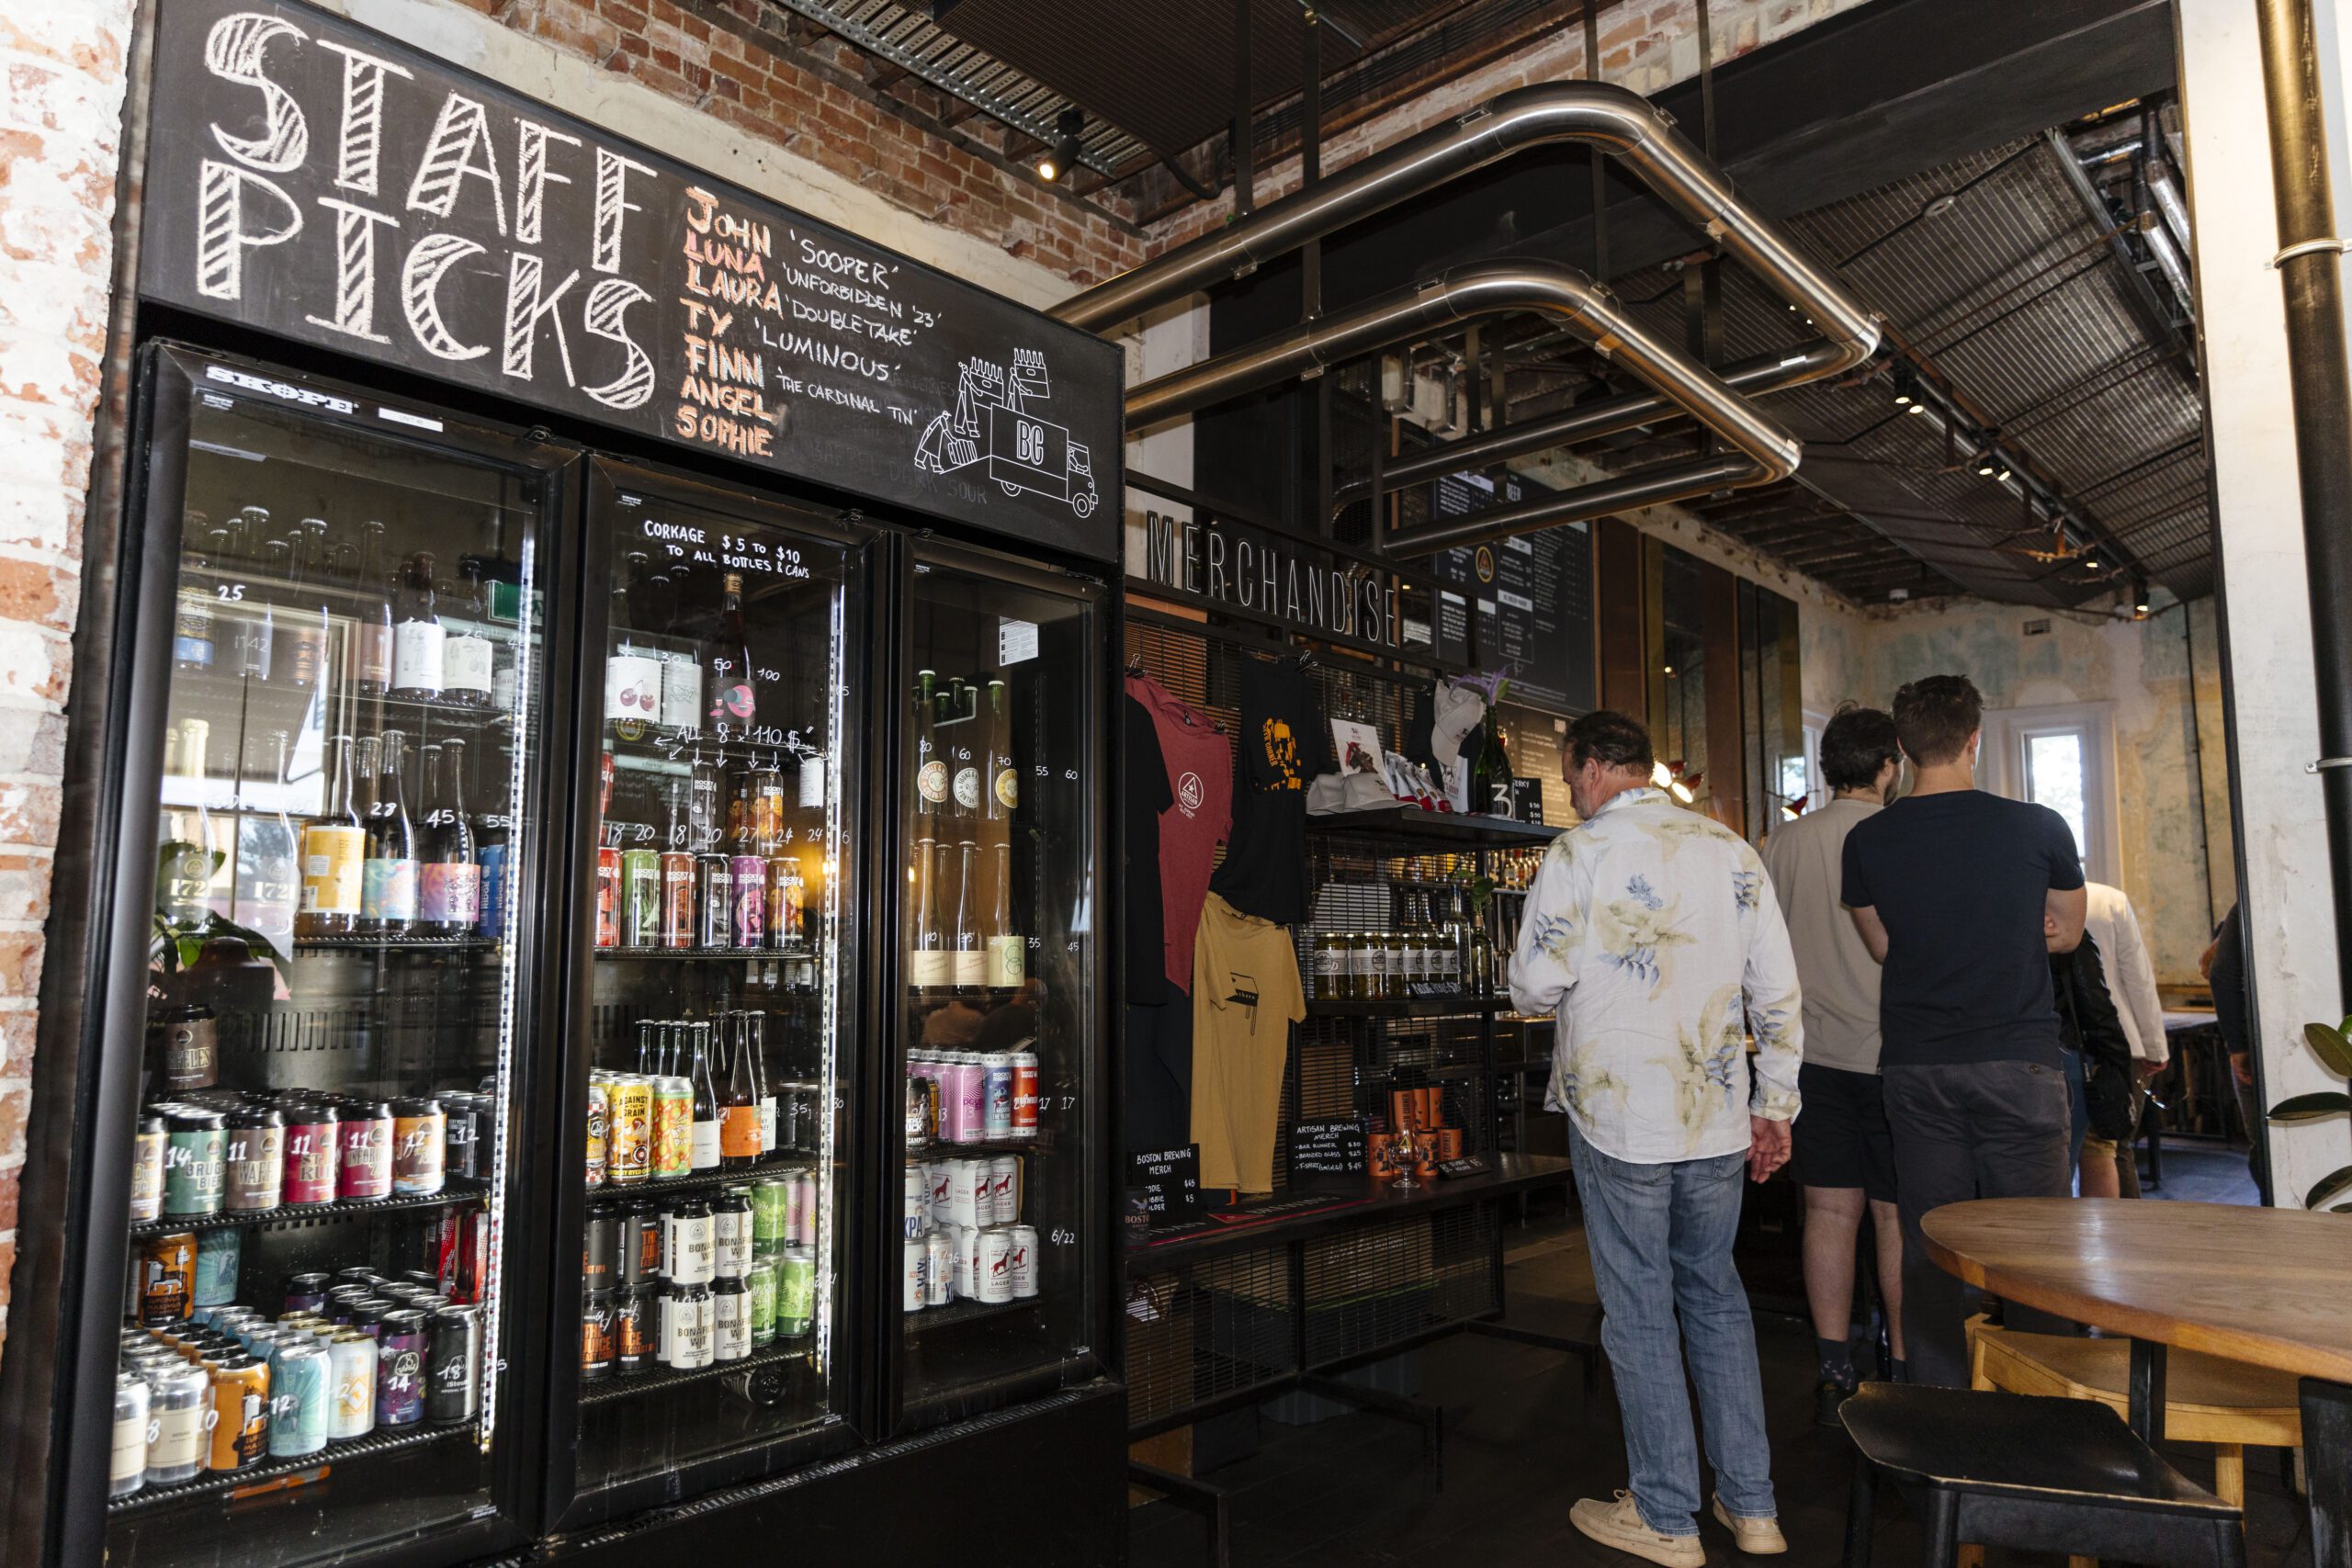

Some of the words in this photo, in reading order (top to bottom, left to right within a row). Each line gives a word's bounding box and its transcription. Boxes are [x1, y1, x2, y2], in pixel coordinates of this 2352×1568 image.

[206, 13, 658, 274] STAFF
[685, 186, 771, 258] JOHN
[684, 231, 765, 280] LUNA
[198, 159, 655, 410] PICKS
[684, 259, 784, 320] LAURA
[679, 298, 733, 337] TY
[683, 333, 765, 389] FINN
[808, 383, 880, 413] CARDINAL
[206, 366, 354, 414] SKOPE
[681, 375, 777, 425] ANGEL
[675, 407, 773, 457] SOPHIE
[644, 519, 706, 544] CORKAGE
[752, 543, 766, 554] TO
[776, 546, 800, 564] $10
[666, 544, 684, 557] TO
[694, 550, 716, 563] ALL
[723, 554, 772, 571] BOTTLES
[785, 564, 810, 579] CANS
[1148, 512, 1399, 647] MERCHANDISE
[218, 584, 246, 602] 25
[714, 658, 732, 670] 50
[757, 668, 780, 681] 100
[676, 723, 703, 740] ALL
[753, 724, 782, 744] 110
[958, 748, 971, 760] 60
[998, 756, 1012, 765] 70
[1035, 766, 1048, 776] 55
[1066, 770, 1078, 780] 60
[370, 801, 397, 817] 28
[426, 809, 456, 828] 45
[606, 824, 625, 845] 18
[635, 823, 655, 841] 20
[669, 824, 687, 845] 18
[739, 826, 759, 843] 27
[776, 827, 793, 844] 24
[808, 827, 822, 842] 24
[1028, 937, 1040, 948] 35
[1068, 942, 1079, 952] 45
[619, 1095, 649, 1106] AGAINST
[1039, 1097, 1051, 1110] 17
[1060, 1096, 1076, 1110] 17
[458, 1127, 480, 1144] 12
[1296, 1124, 1325, 1134] ARTISAN
[1329, 1123, 1360, 1133] BREWING
[1314, 1133, 1339, 1141] MERCH
[291, 1134, 311, 1155] 11
[350, 1132, 368, 1148] 11
[164, 1145, 192, 1168] 14
[229, 1141, 247, 1161] 11
[1136, 1152, 1161, 1165] BOSTON
[1164, 1148, 1191, 1161] BREWING
[1148, 1164, 1171, 1175] MERCH
[1185, 1194, 1194, 1203] $5
[1051, 1228, 1075, 1246] 6/22
[388, 1375, 412, 1393] 14
[270, 1396, 291, 1415] 12
